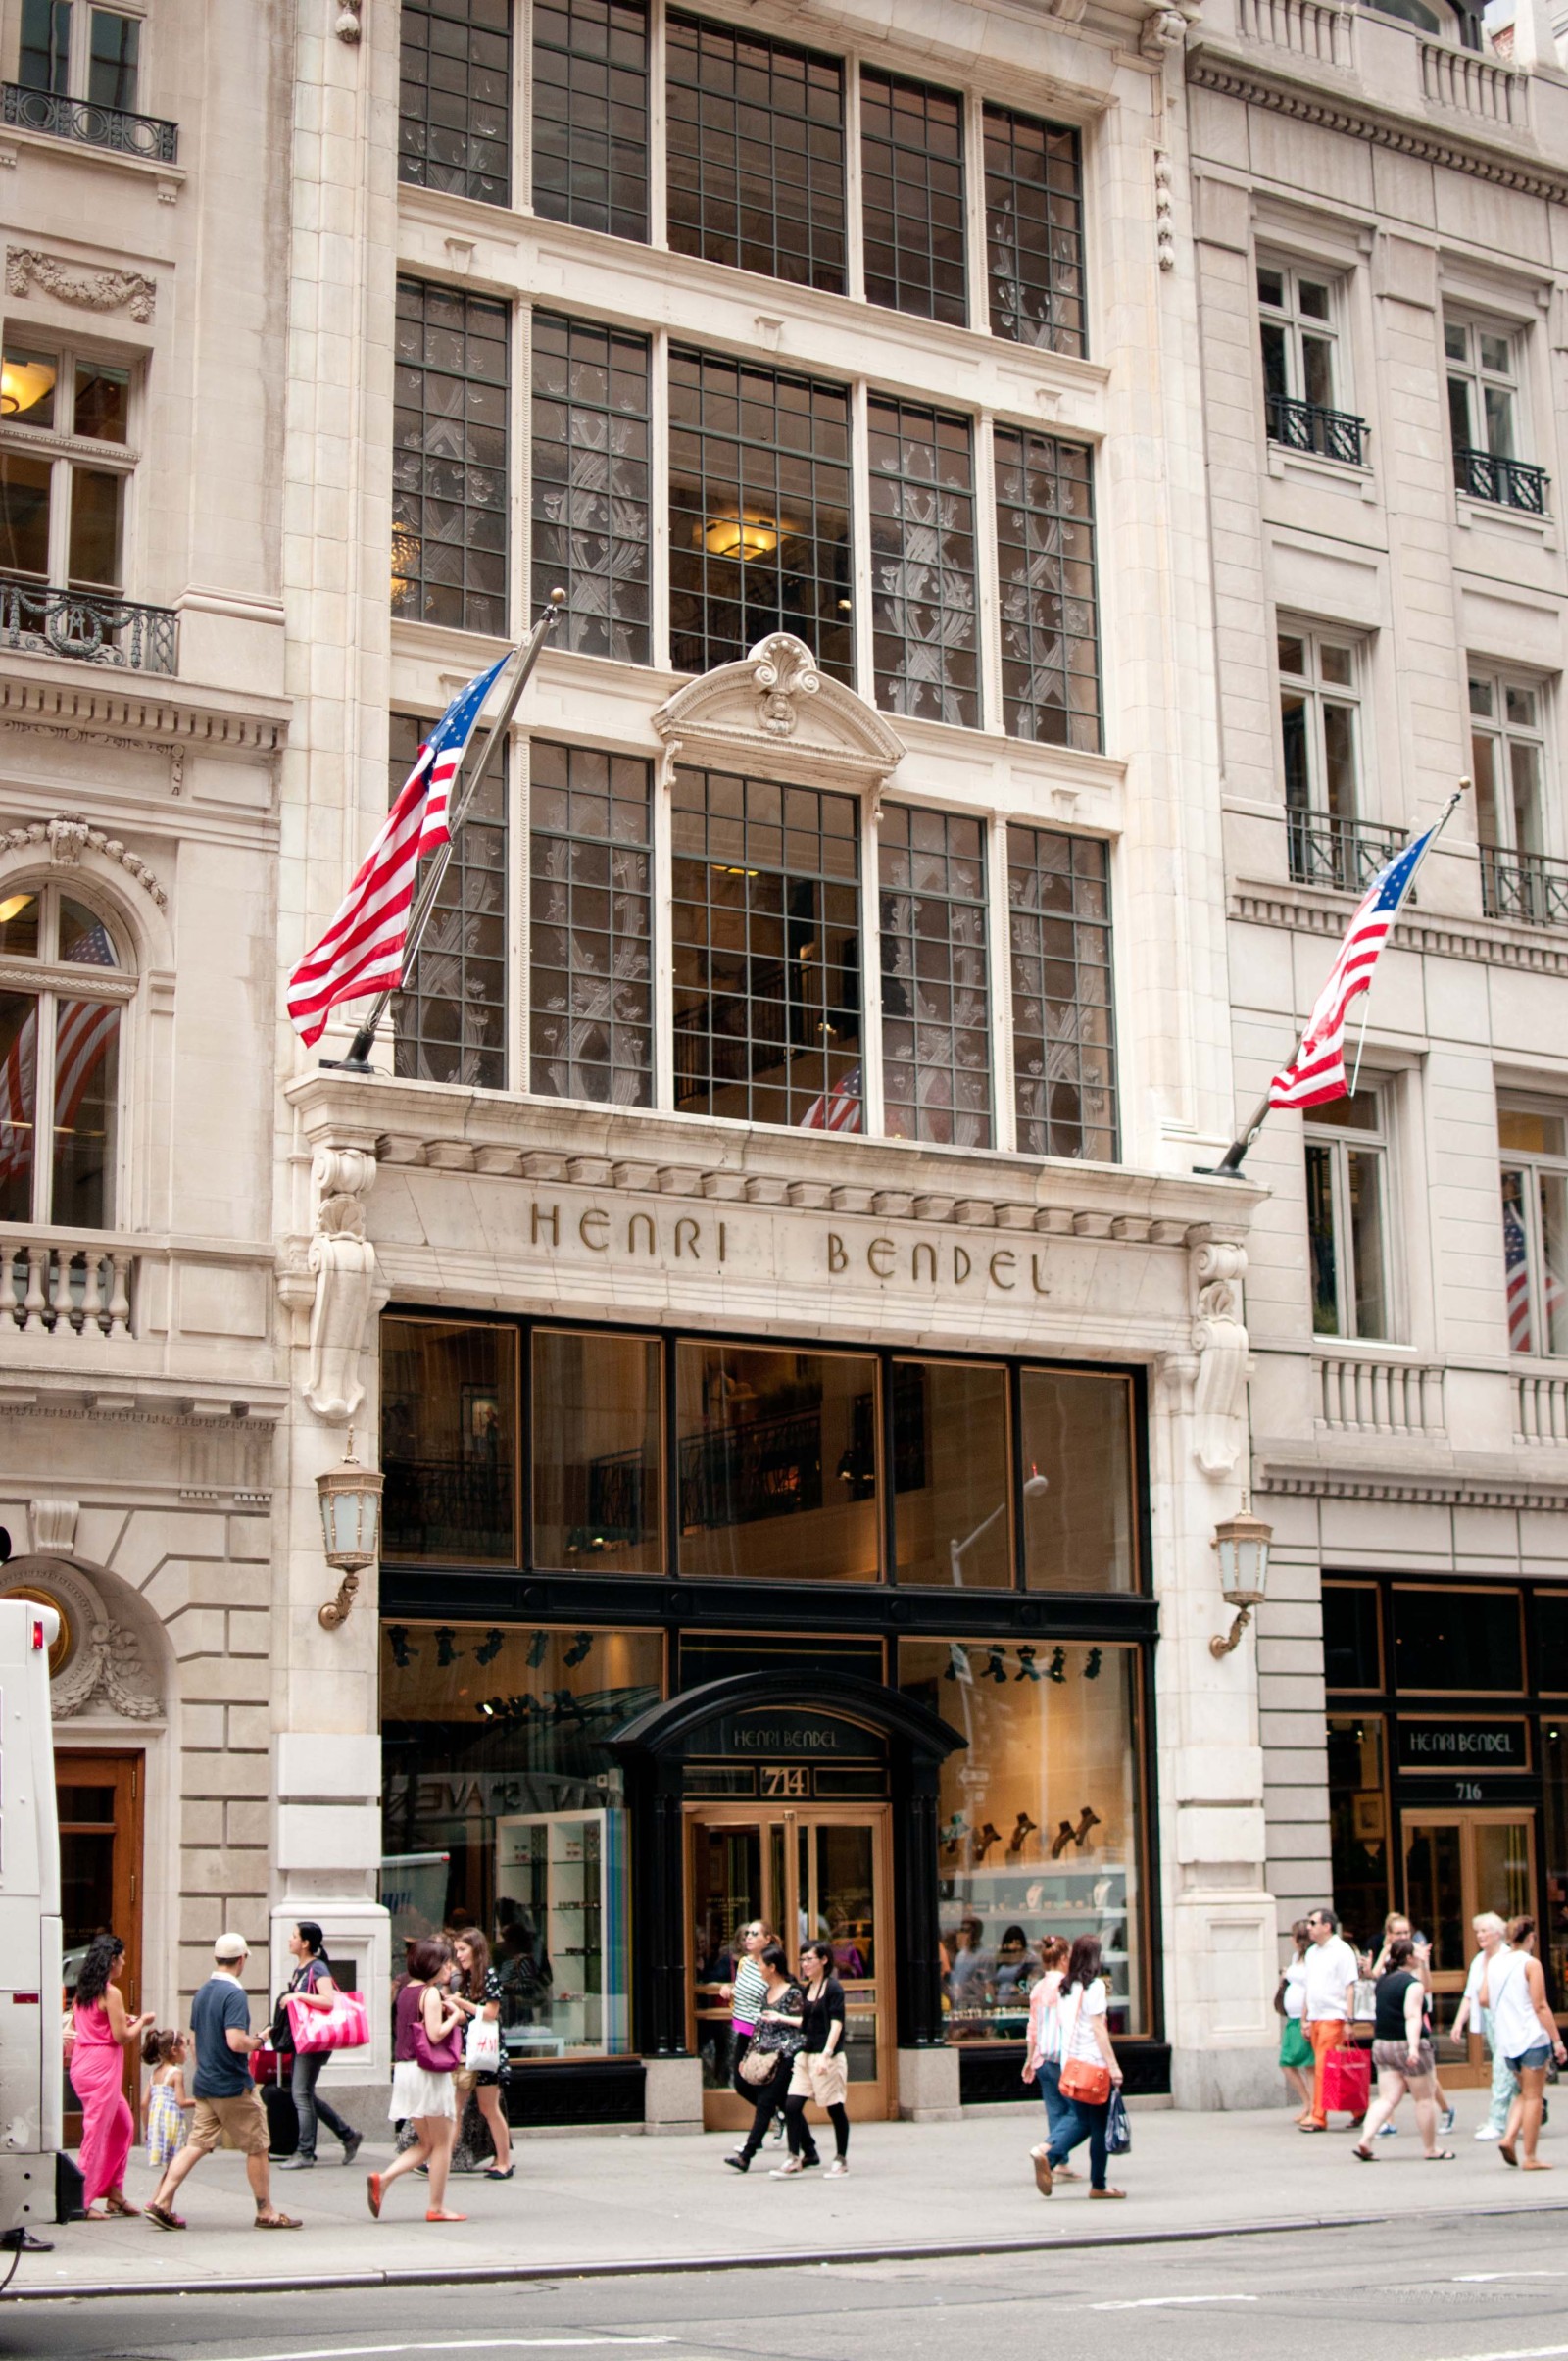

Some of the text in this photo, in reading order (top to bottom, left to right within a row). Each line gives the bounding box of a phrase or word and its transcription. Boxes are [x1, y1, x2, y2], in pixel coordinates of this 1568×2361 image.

[531, 1203, 1052, 1295] HENRI BENDEL
[734, 1730, 841, 1748] HENRI BENDEL
[1410, 1733, 1514, 1753] HENRI BENDEL
[764, 1768, 805, 1795] 714
[1455, 1783, 1482, 1800] 716
